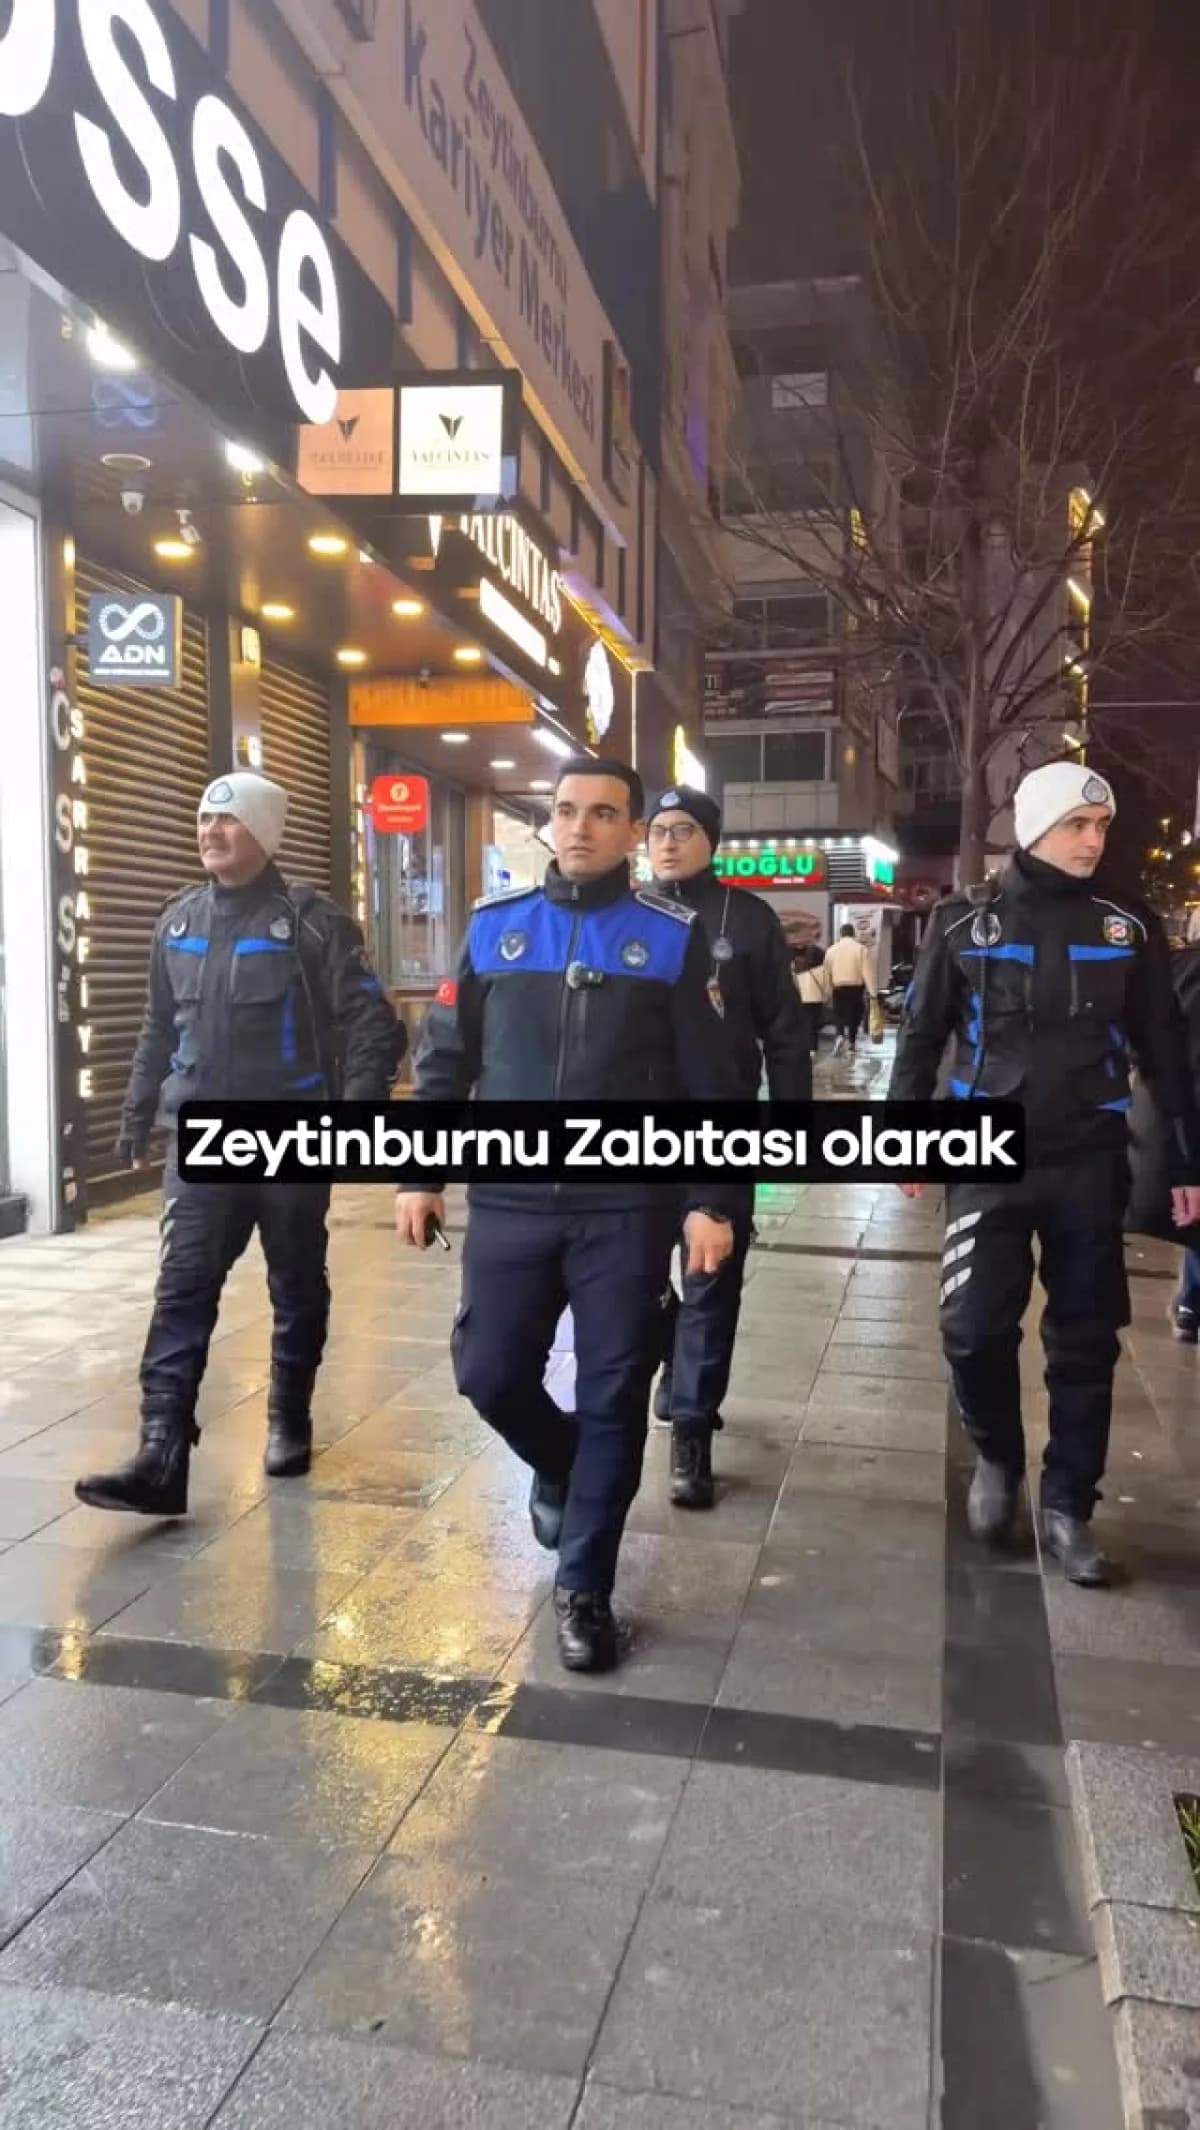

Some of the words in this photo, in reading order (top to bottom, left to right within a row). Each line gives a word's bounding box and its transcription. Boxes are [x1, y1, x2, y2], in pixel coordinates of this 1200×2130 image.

[463, 20, 567, 304] Zeytinburnu
[519, 234, 595, 444] Merkezi
[99, 645, 166, 664] ADN
